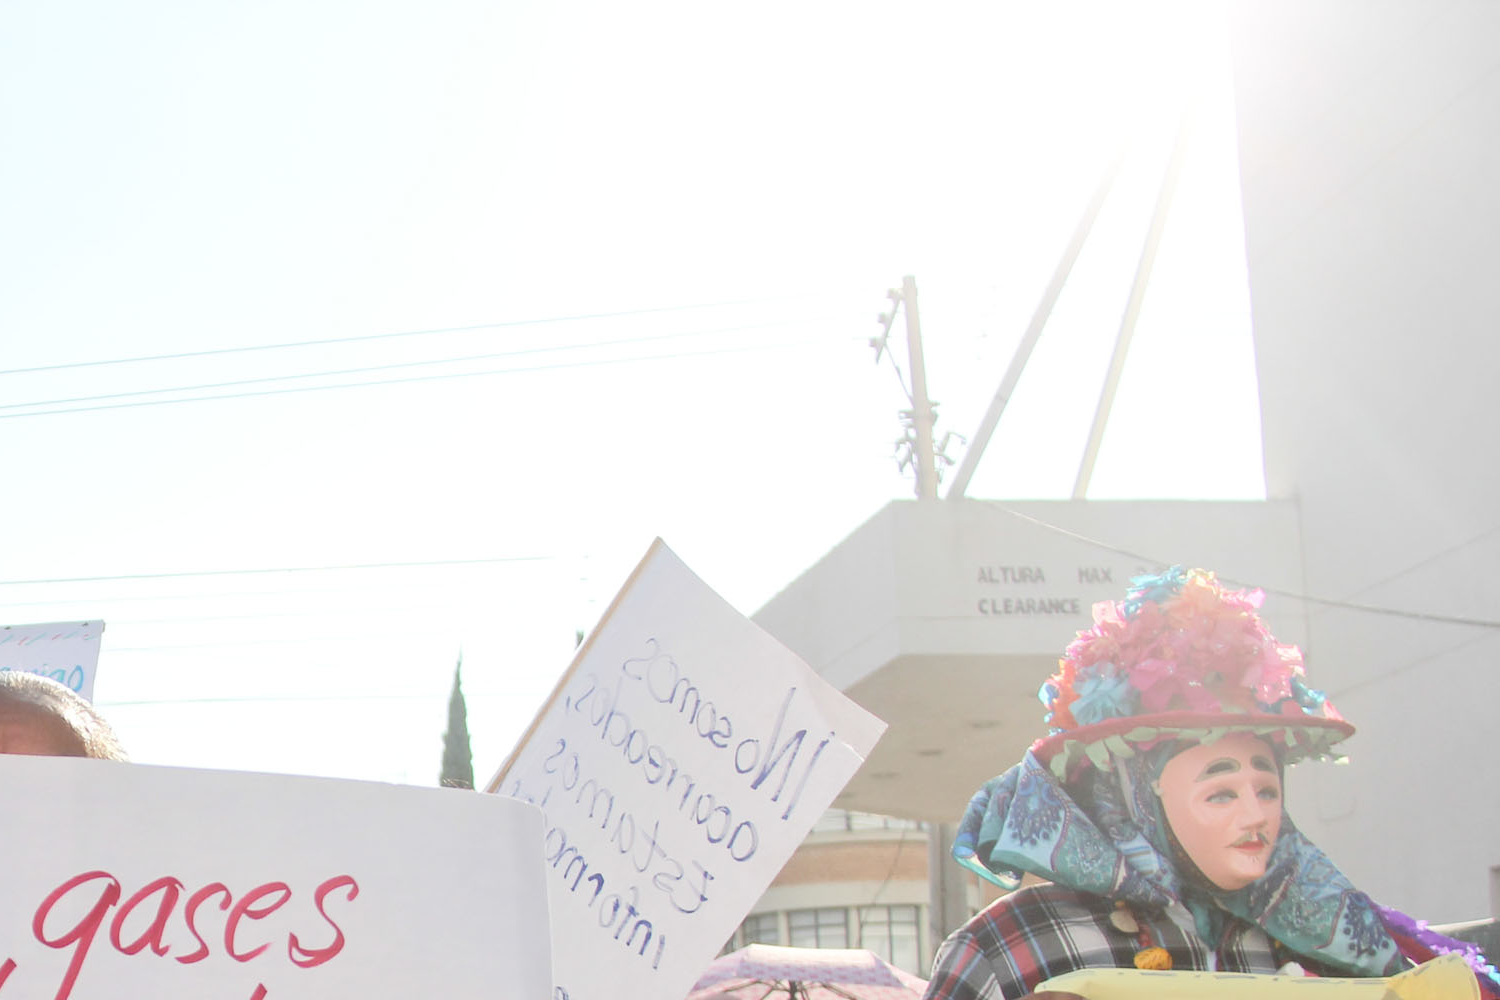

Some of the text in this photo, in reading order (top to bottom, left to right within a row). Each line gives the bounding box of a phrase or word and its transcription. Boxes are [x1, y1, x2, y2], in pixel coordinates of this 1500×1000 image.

[977, 566, 1045, 584] ALTURA
[1077, 566, 1113, 584] MAX
[977, 599, 1080, 615] CLEARANCE
